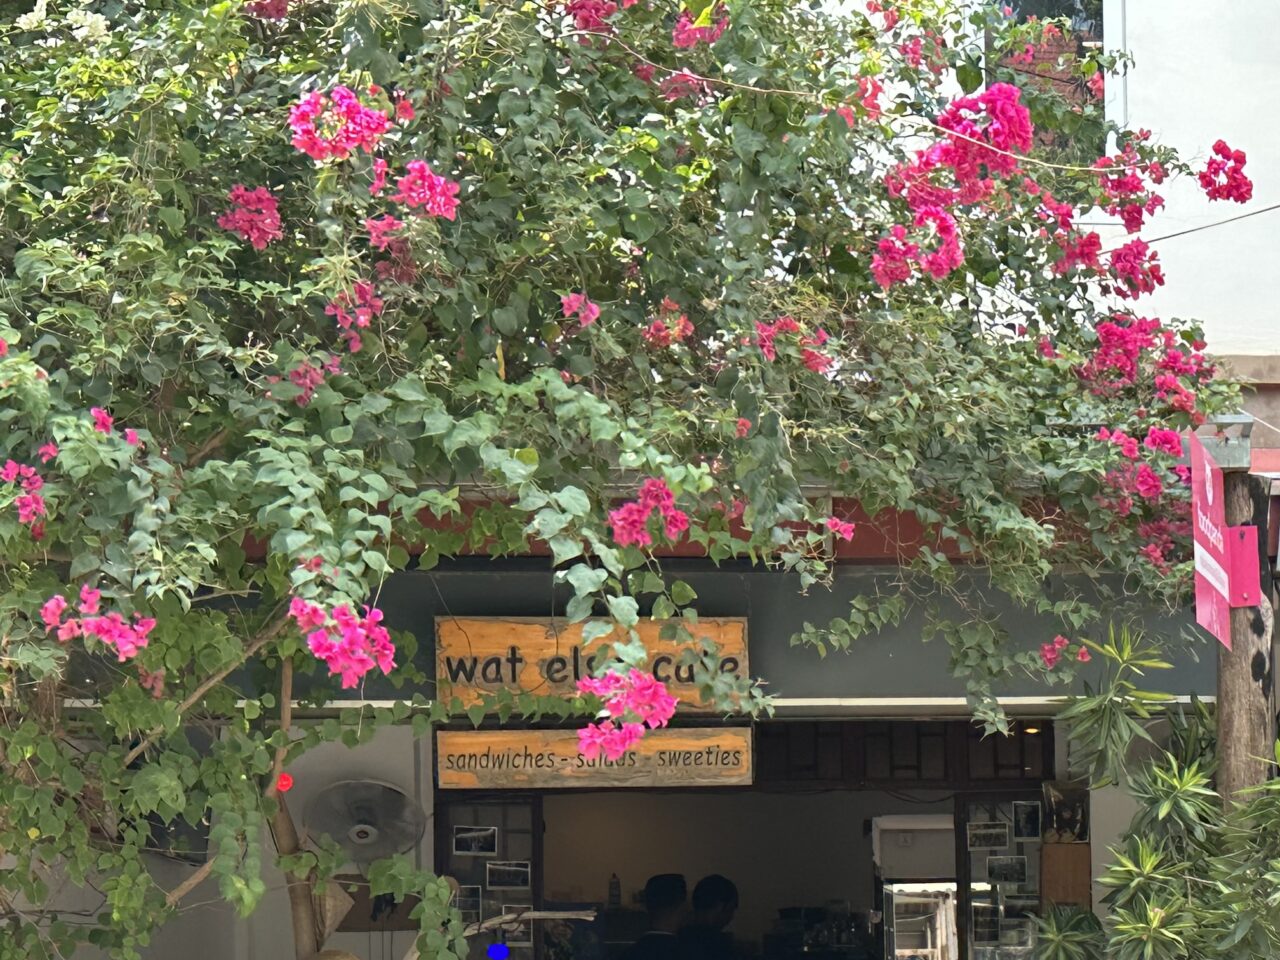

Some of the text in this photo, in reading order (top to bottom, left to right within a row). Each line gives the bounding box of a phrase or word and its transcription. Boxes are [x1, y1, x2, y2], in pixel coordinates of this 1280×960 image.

[446, 645, 523, 684] wat
[546, 645, 626, 684] el
[446, 745, 556, 770] sandwiches
[657, 745, 742, 768] sweeties
